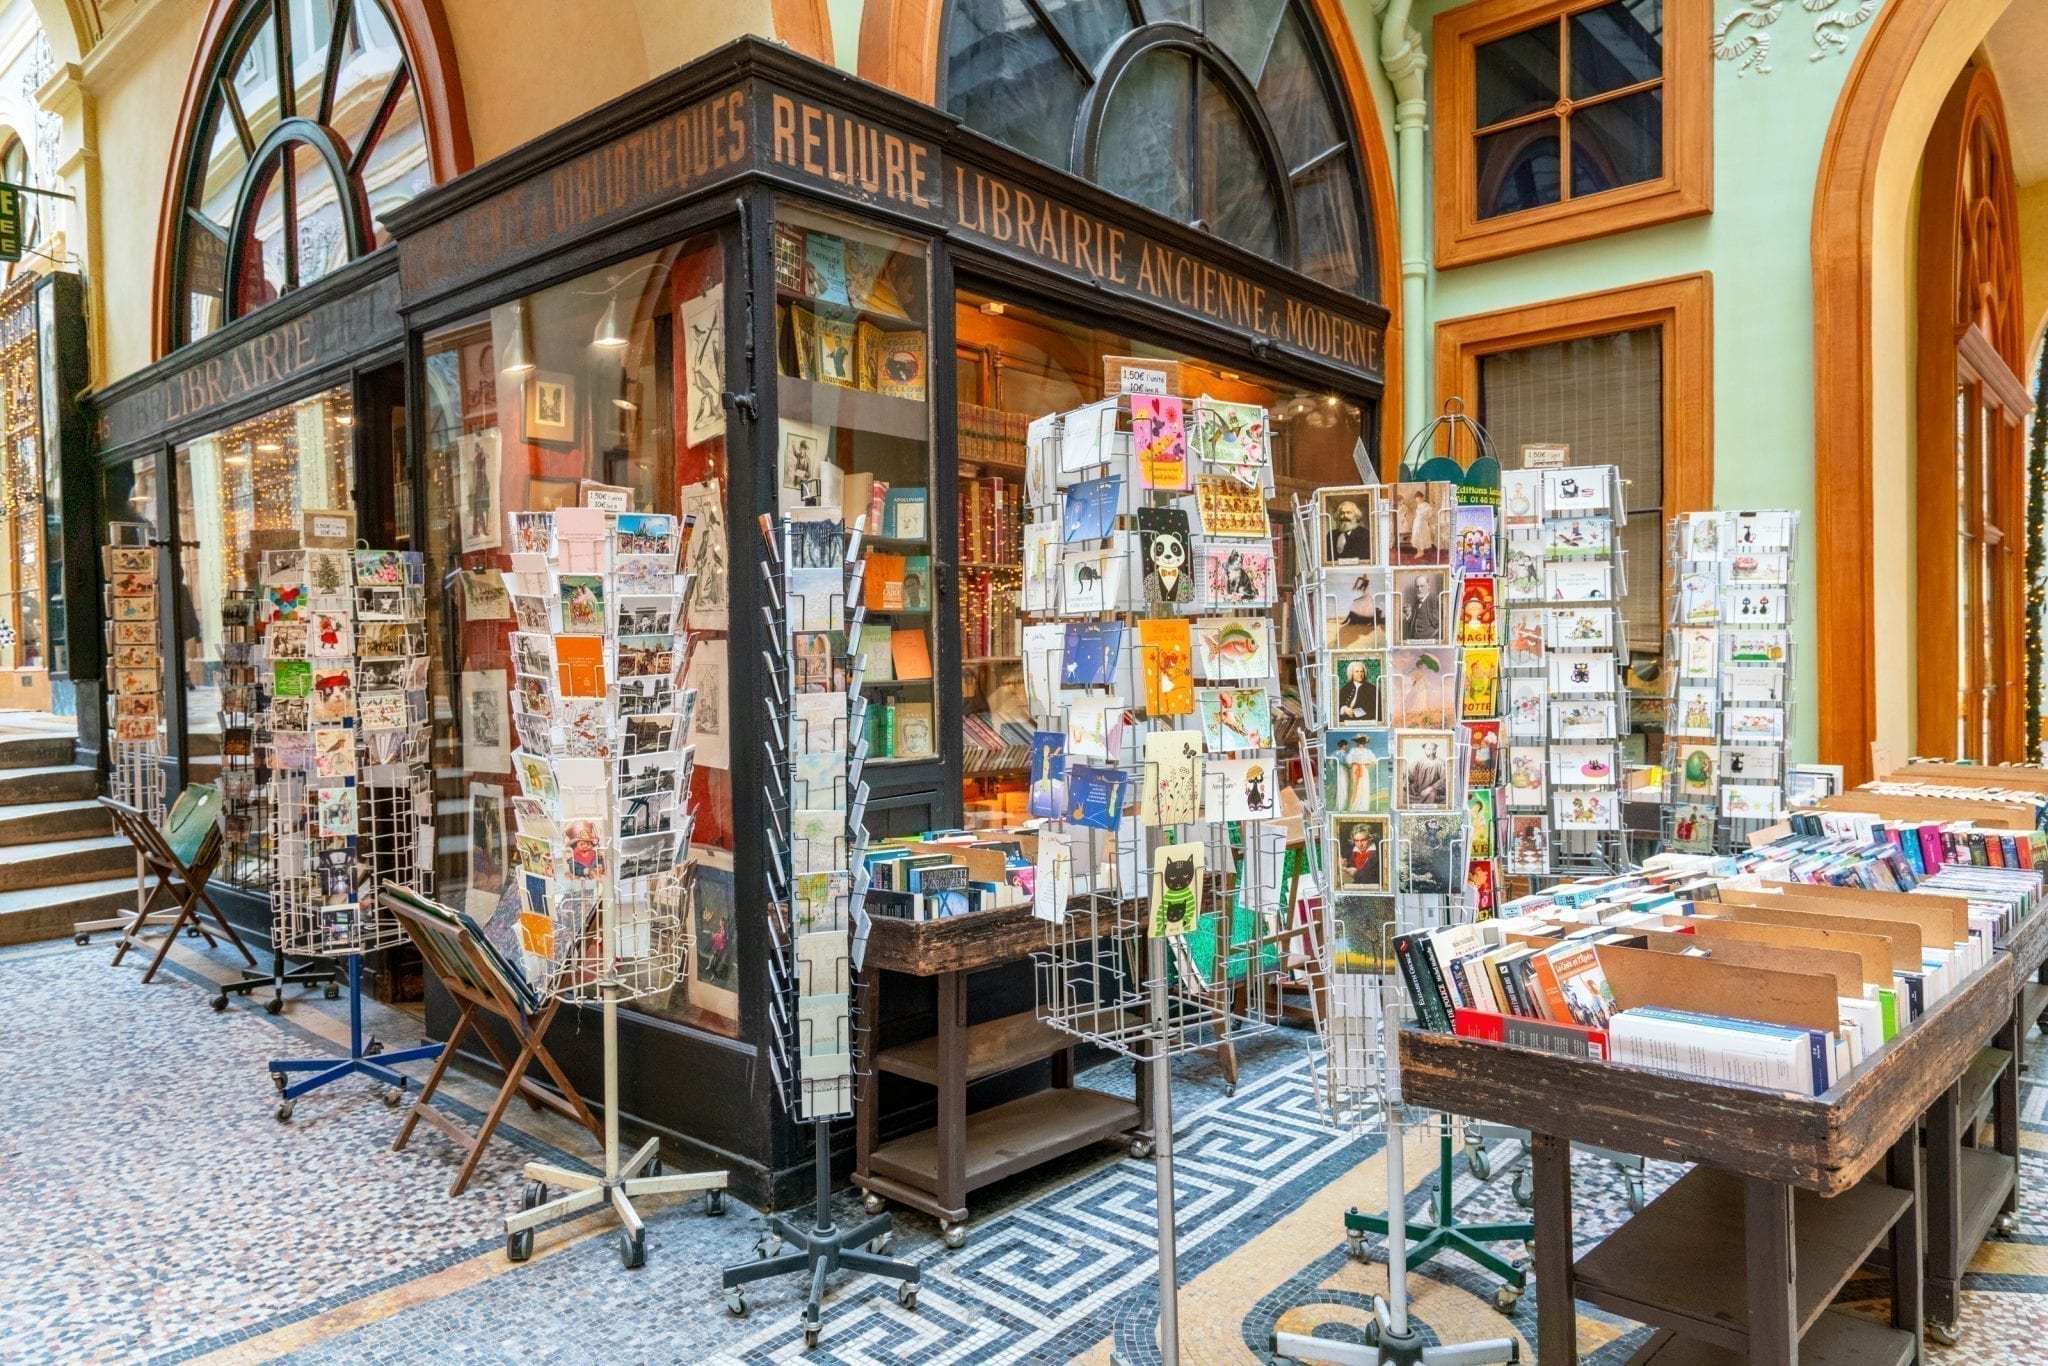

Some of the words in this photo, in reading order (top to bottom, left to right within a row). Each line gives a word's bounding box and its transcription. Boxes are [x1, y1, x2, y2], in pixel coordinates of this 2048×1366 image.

[552, 89, 746, 234] BIBLIOTHEQUES
[771, 92, 930, 210] RELIURE
[956, 166, 1126, 285] LIBRAIRIE
[1136, 241, 1267, 335] ANCIENNE
[1270, 310, 1281, 341] &
[1286, 297, 1378, 372] MODERNE
[165, 314, 317, 423] LIBRAIRIE
[1123, 369, 1145, 381] 1,50€
[1130, 383, 1144, 392] 10€
[1456, 633, 1495, 643] MAGIK
[1438, 984, 1450, 1008] POLICE
